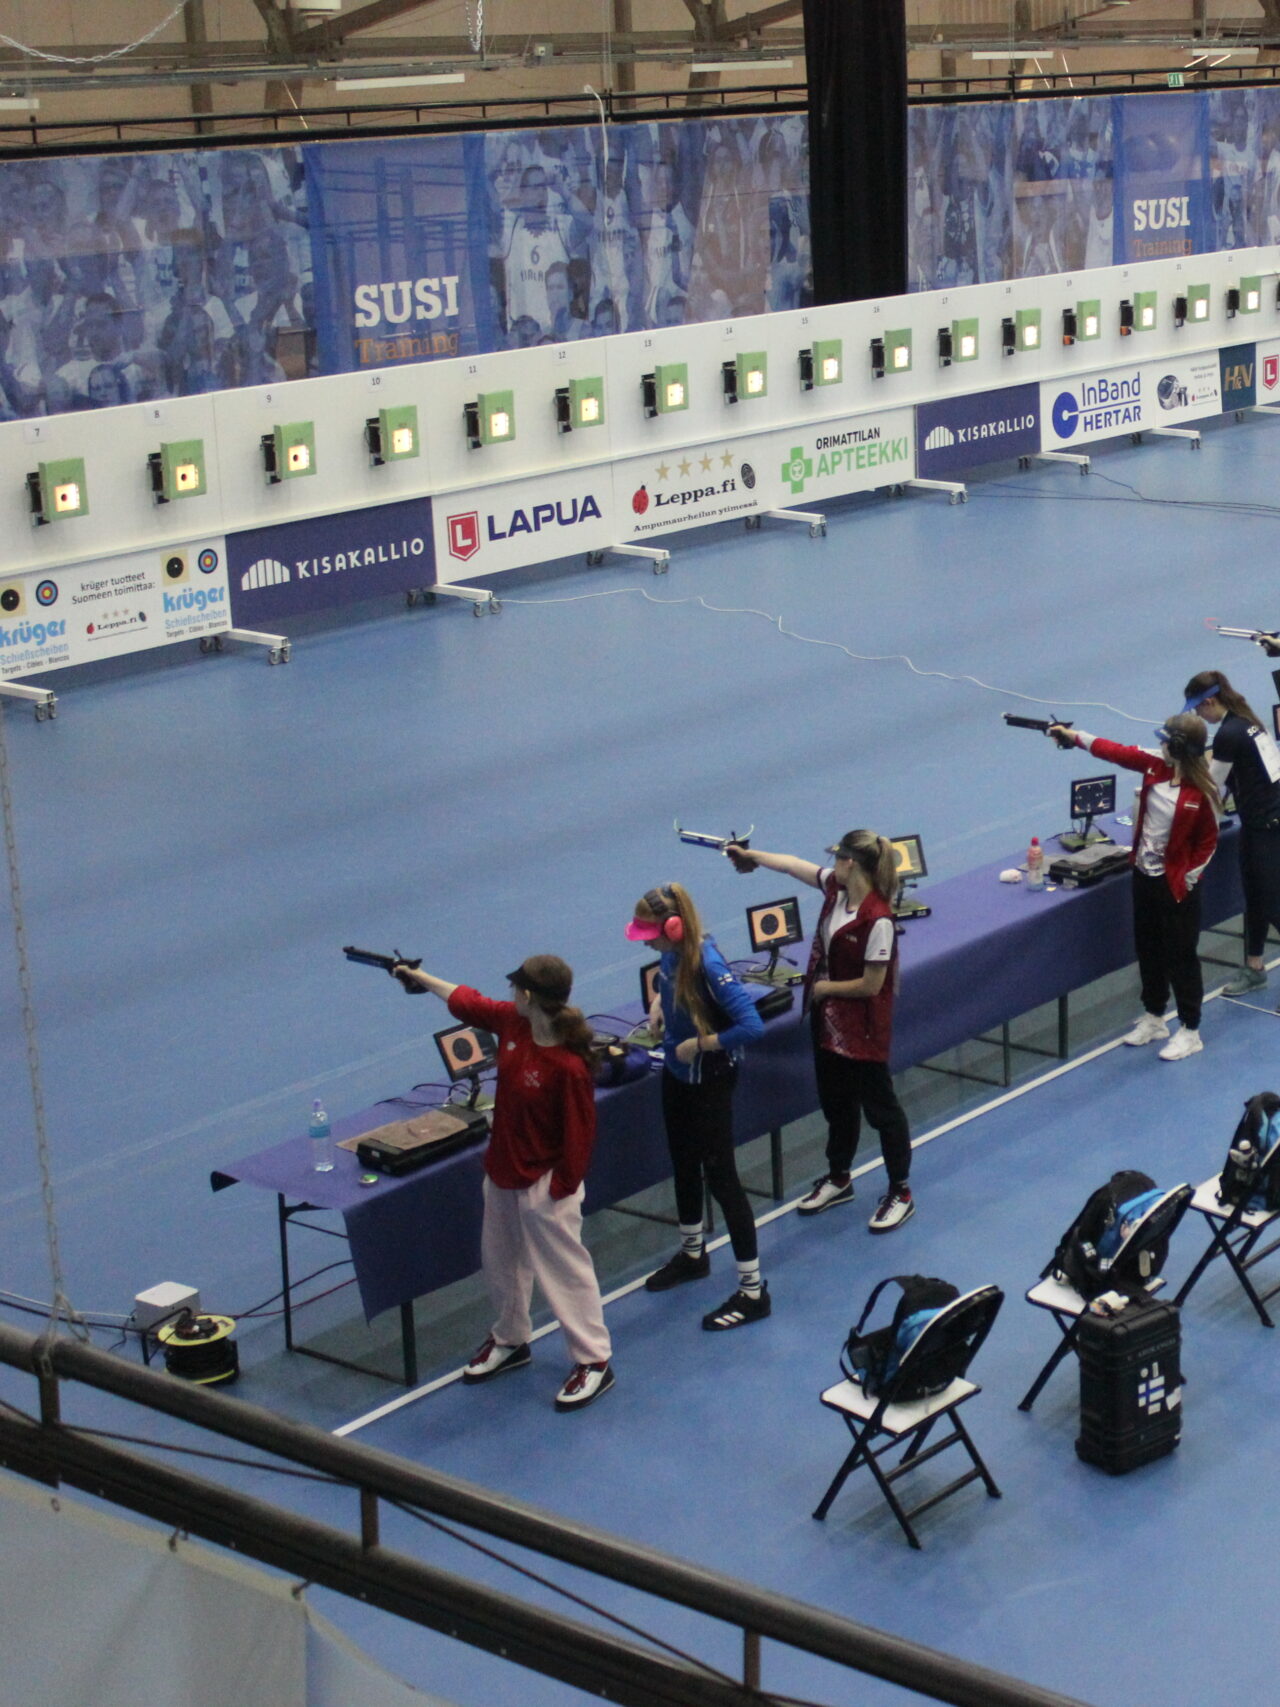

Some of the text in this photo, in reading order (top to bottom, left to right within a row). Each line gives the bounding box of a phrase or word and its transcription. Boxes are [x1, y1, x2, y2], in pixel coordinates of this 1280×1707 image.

[1133, 196, 1191, 231] SUSI
[531, 245, 541, 265] 6
[1133, 238, 1193, 258] Training
[354, 275, 459, 328] SUSI
[873, 306, 880, 314] 16
[941, 297, 948, 305] 17
[726, 327, 733, 335] 14
[801, 317, 808, 325] 15
[355, 333, 460, 363] Training
[558, 351, 566, 359] 12
[644, 340, 652, 348] 13
[468, 365, 477, 374] 11
[371, 377, 381, 386] 10
[1082, 371, 1141, 407] InBand
[266, 394, 272, 403] 9
[154, 409, 160, 419] 8
[1083, 405, 1141, 432] HERTAR
[34, 428, 40, 437] 7
[816, 427, 880, 450] ORIMATTILAN
[957, 414, 1035, 443] KISAKALLIO
[817, 437, 908, 478] APTEEKKI
[654, 478, 737, 507] Leppa.fi
[487, 495, 602, 541] LAPUA
[633, 499, 758, 532] Ampumaurheilun ytimessä
[296, 537, 425, 579] KISAKALLIO
[80, 571, 145, 592] krüger tuotteet
[71, 581, 156, 605] Suomeen toimittaa:
[163, 585, 224, 614] krüger
[164, 608, 227, 630] Schießscheiben
[0, 619, 66, 649] krüger
[0, 643, 69, 665] Schießscheiben
